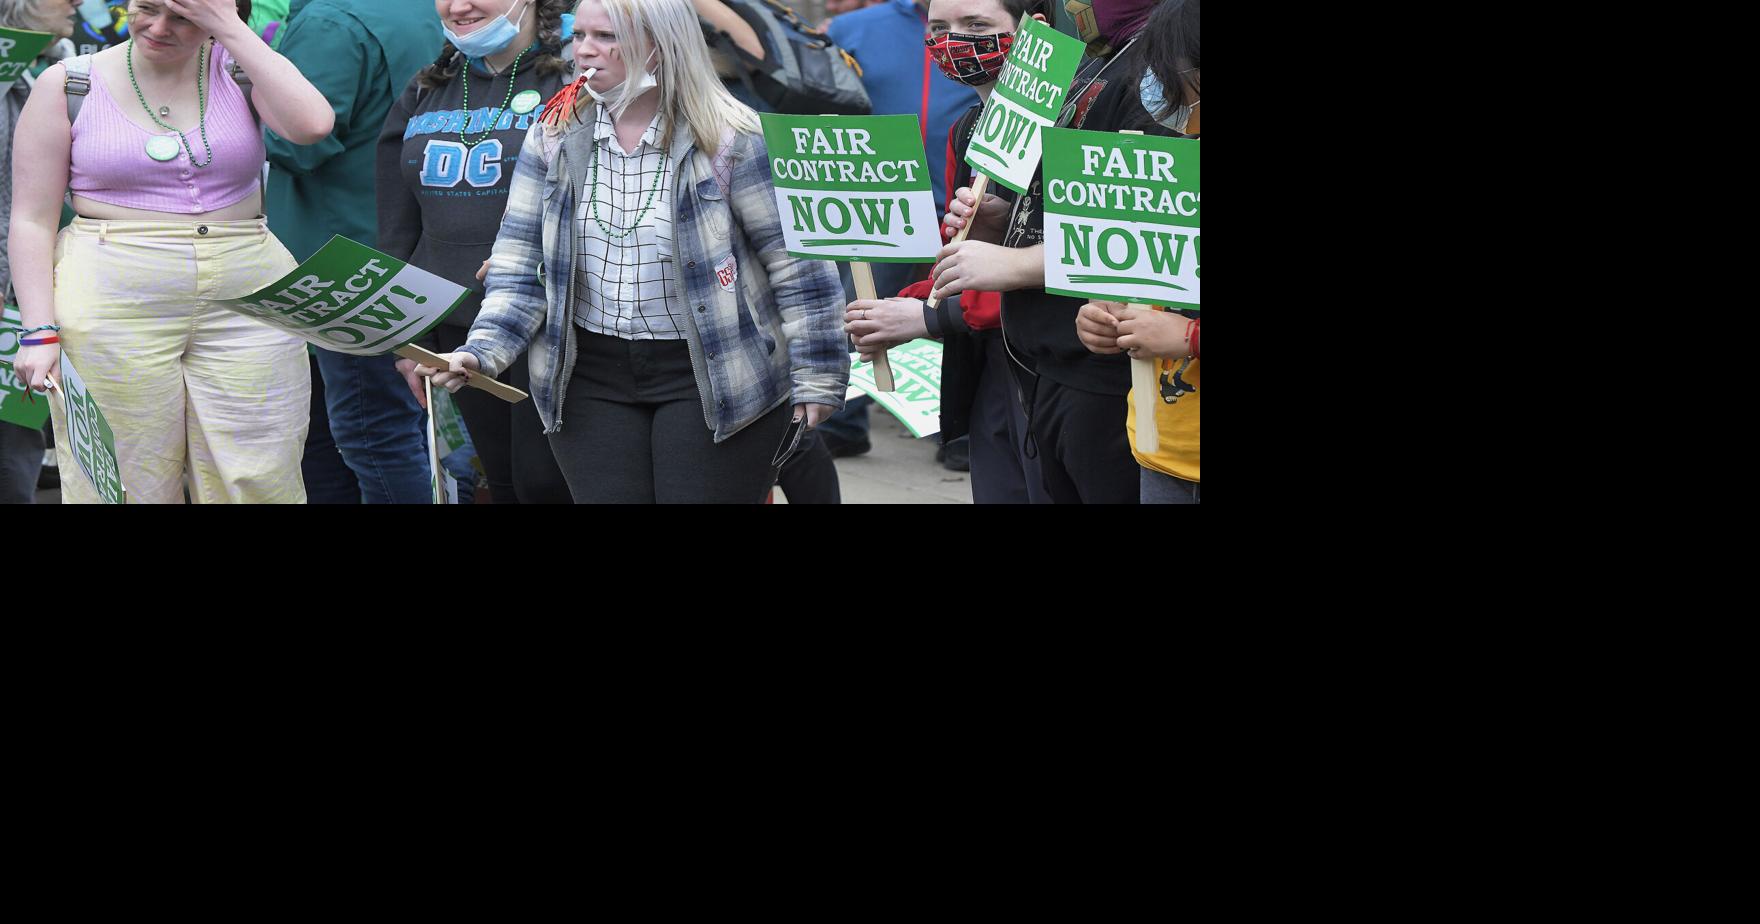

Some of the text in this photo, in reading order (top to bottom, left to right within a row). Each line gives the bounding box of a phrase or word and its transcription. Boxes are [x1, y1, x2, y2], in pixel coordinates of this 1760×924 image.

[1012, 29, 1054, 72] FAIR
[999, 59, 1062, 109] ONTRACT
[791, 127, 876, 155] FAIR
[419, 138, 503, 188] DC
[773, 157, 920, 183] CONTRACT
[1081, 145, 1178, 183] FAIR
[787, 195, 914, 235] NOW!
[1048, 178, 1200, 217] CONTRAC
[237, 274, 335, 315] FAIR
[317, 284, 428, 345] OW!
